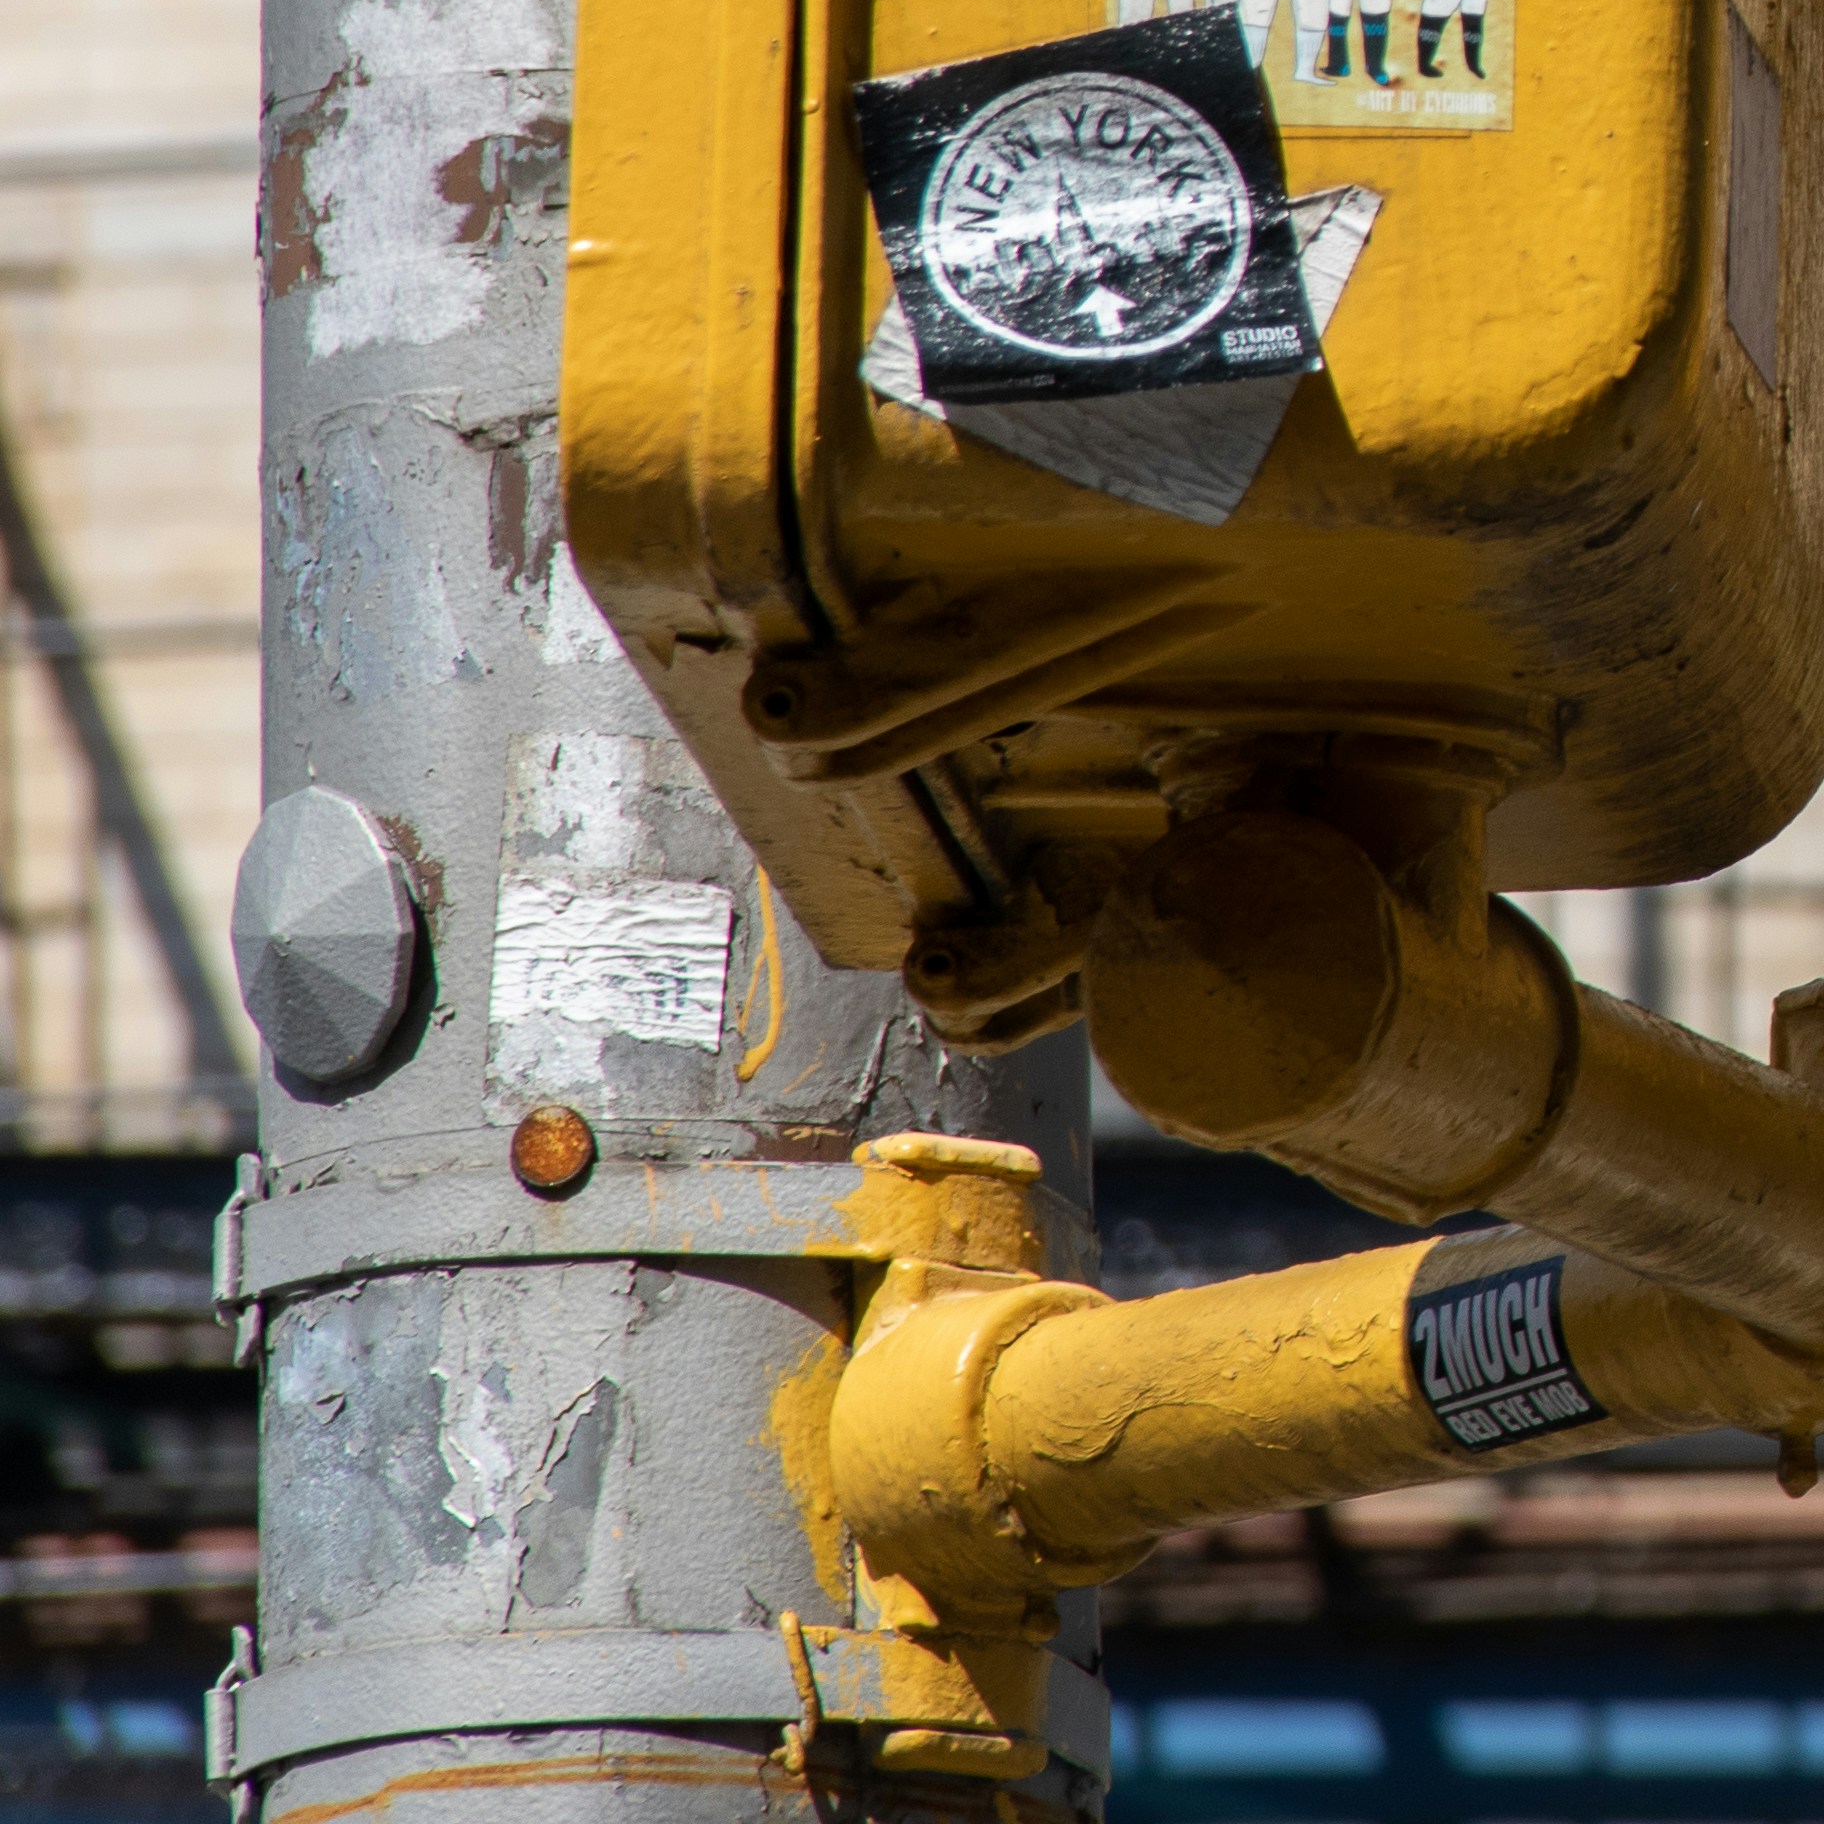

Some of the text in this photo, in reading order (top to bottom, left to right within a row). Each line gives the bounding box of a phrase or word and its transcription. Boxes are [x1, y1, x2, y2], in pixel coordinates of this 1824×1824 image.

[953, 102, 1208, 235] NEW YORK
[1222, 323, 1299, 348] STUDIO
[1413, 1272, 1561, 1402] 2MUCH
[1445, 1380, 1591, 1445] RED EYE MOB
